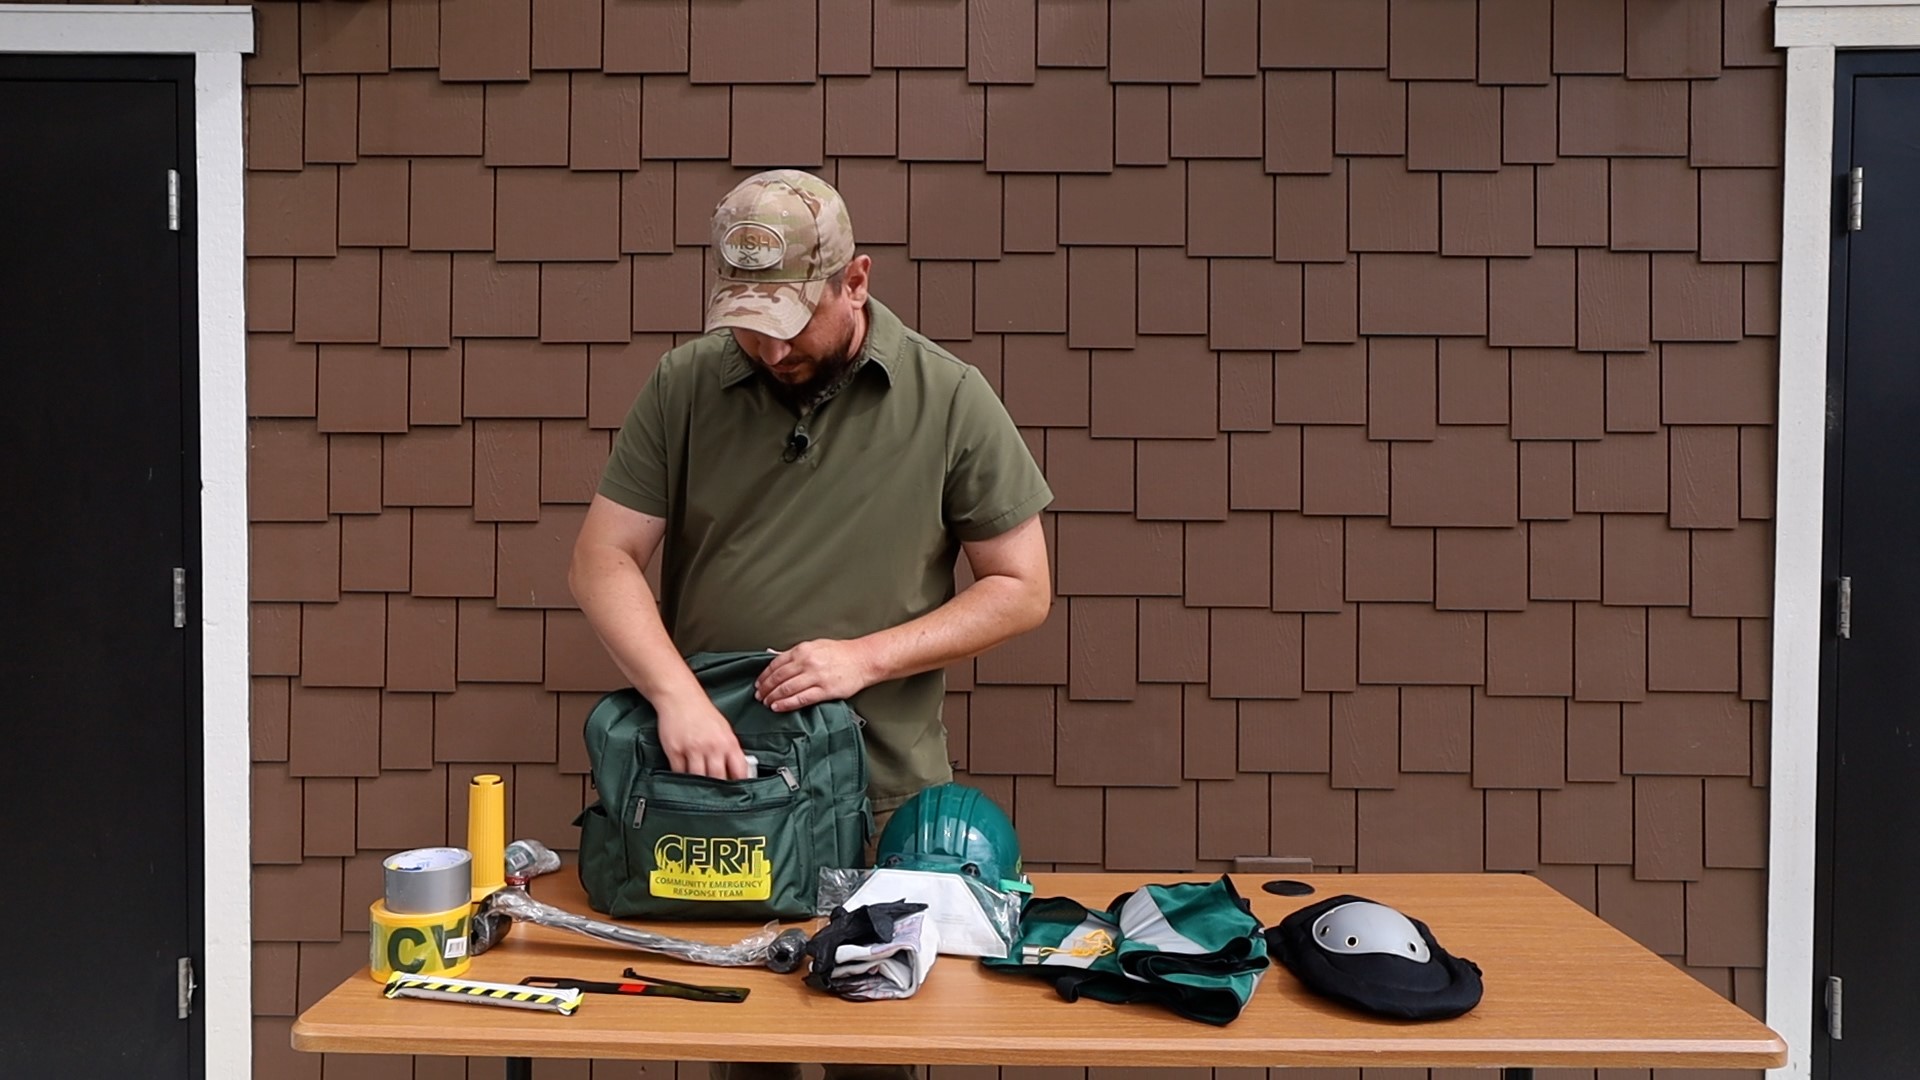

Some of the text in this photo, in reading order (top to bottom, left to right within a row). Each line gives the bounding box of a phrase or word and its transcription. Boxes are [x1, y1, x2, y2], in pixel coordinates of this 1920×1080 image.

[654, 834, 766, 876] CERT
[655, 876, 763, 888] COMMUNITY EMERGENCY
[673, 887, 744, 898] RESPONSE TEAM
